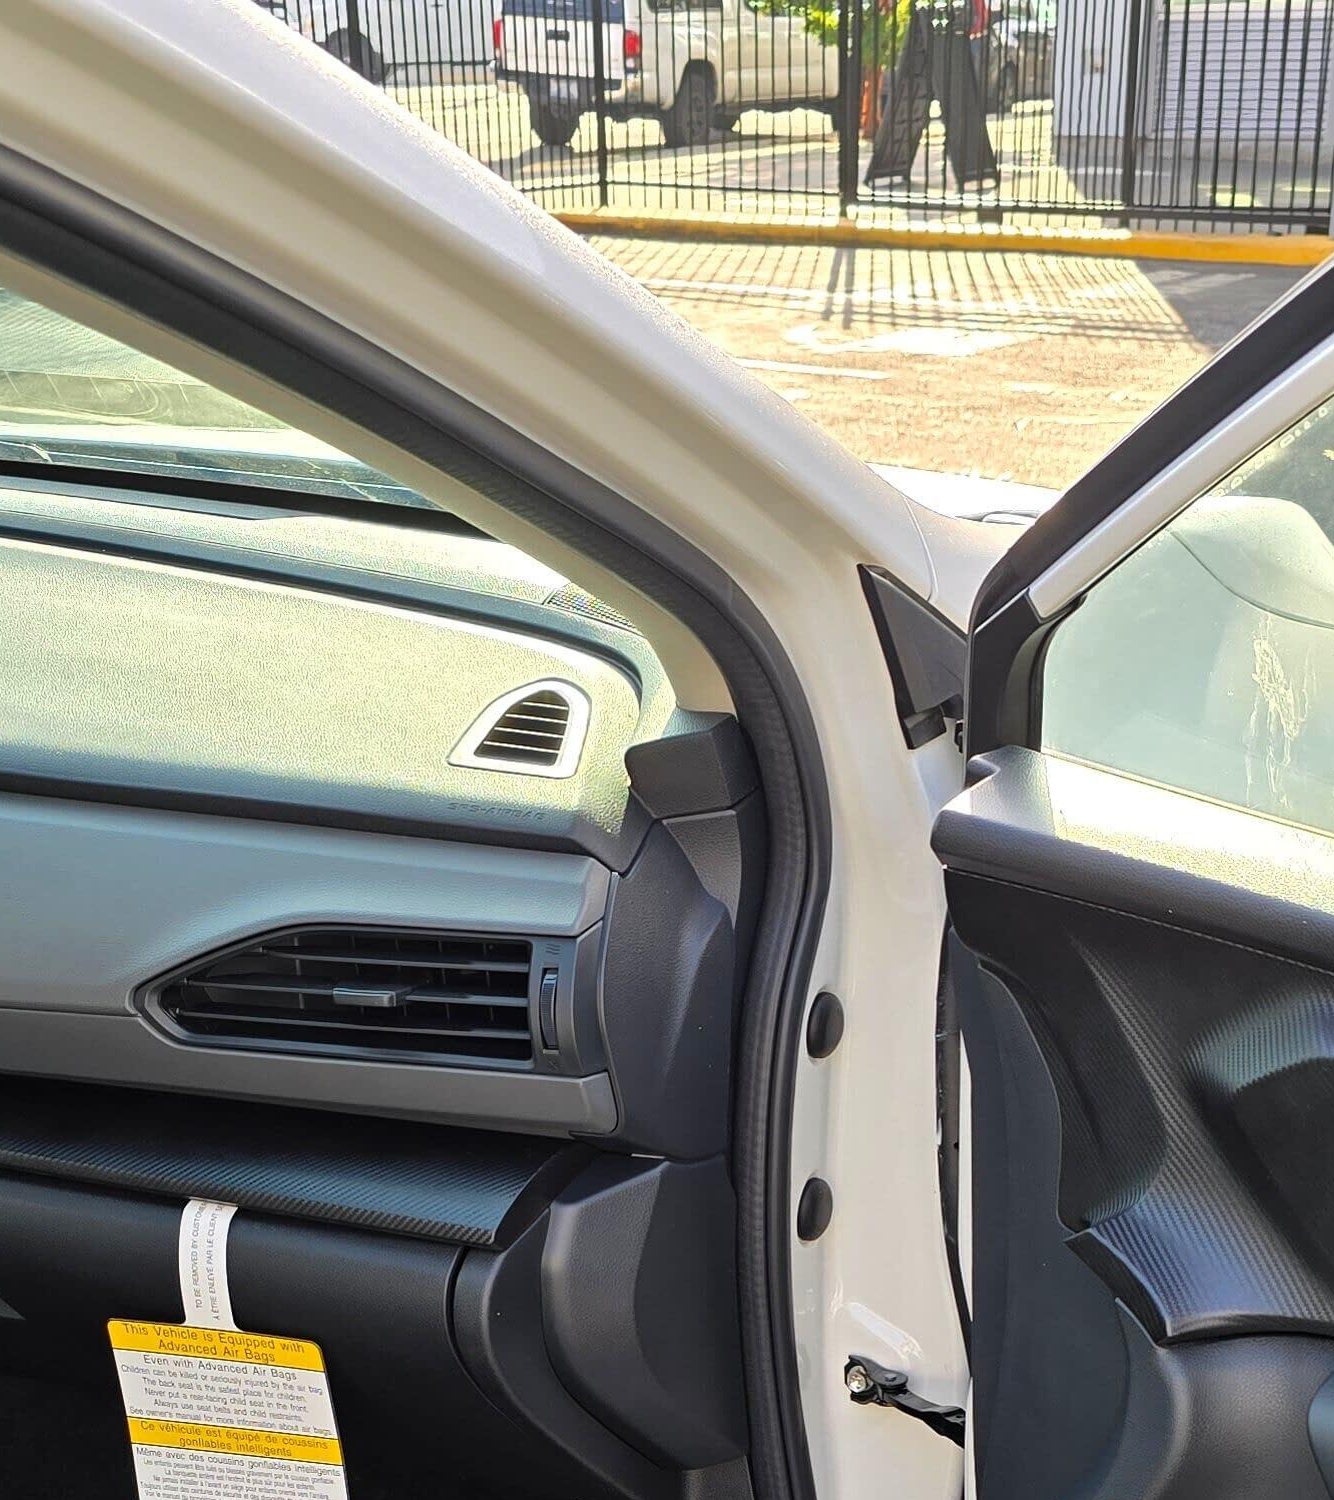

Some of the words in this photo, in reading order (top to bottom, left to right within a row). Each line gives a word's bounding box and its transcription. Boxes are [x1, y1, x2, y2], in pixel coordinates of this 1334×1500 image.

[207, 1212, 219, 1237] CLIENT
[191, 1239, 199, 1249] BY
[207, 1239, 214, 1248] LE
[206, 1249, 214, 1265] PAR
[191, 1251, 199, 1286] REMOVED
[194, 1288, 202, 1297] BE
[196, 1299, 203, 1309] TO
[123, 1323, 149, 1336] This
[153, 1325, 198, 1341] Vehicle
[203, 1331, 213, 1342] is
[218, 1332, 276, 1349] Equipped
[279, 1342, 305, 1354] with
[158, 1339, 218, 1355] Advanced
[223, 1346, 238, 1358] Air
[244, 1348, 276, 1364] Bags
[121, 1364, 150, 1376] Children
[168, 1369, 178, 1378] be
[179, 1370, 198, 1381] killed
[200, 1373, 208, 1381] or
[270, 1380, 280, 1391] by
[143, 1354, 170, 1366] Even
[173, 1358, 194, 1368] with
[198, 1360, 248, 1375] Advanced
[252, 1366, 267, 1377] Air
[270, 1368, 298, 1382] Bags
[142, 1376, 157, 1386] The
[158, 1378, 175, 1388] back
[178, 1382, 194, 1391] seat
[144, 1387, 166, 1397] Never
[168, 1390, 180, 1400] put
[140, 1420, 156, 1431] Ce
[205, 1428, 222, 1438] est
[265, 1434, 278, 1444] de
[282, 1437, 328, 1450] coussins
[179, 1437, 232, 1451] gonflables
[236, 1443, 293, 1457] intelligents
[165, 1451, 186, 1460] avec
[188, 1452, 205, 1462] des
[207, 1457, 245, 1467] coussins
[248, 1459, 292, 1472] gonflables
[294, 1464, 341, 1477] intelligents
